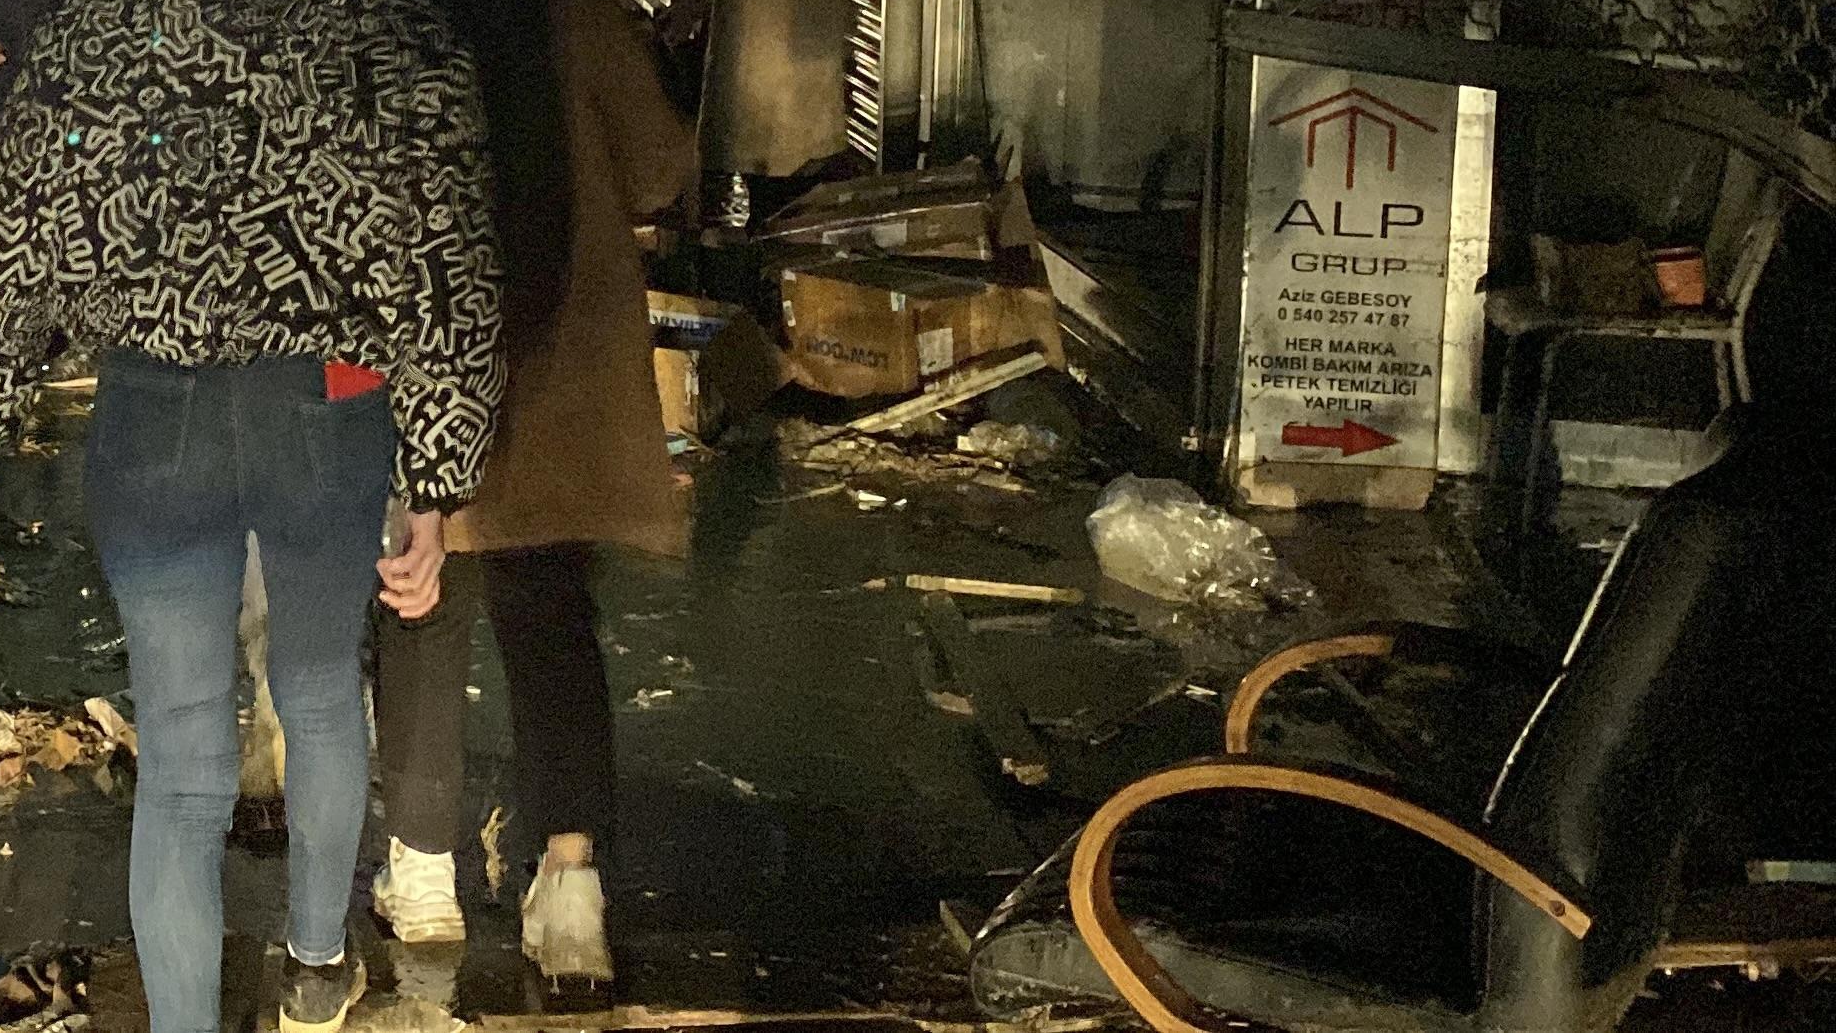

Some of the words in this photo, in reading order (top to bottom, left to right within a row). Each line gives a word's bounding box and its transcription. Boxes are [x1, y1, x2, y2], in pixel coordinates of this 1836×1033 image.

[1273, 198, 1425, 239] ALP
[1290, 252, 1407, 276] GRUP
[1278, 288, 1316, 304] Aziz
[1320, 290, 1413, 309] GEBESOY
[1277, 307, 1287, 321] 0
[1293, 308, 1323, 324] 540
[1328, 309, 1358, 325] 257
[1363, 312, 1385, 326] 47
[1285, 337, 1323, 351] HER
[1328, 339, 1397, 355] MARKA
[1247, 354, 1308, 371] KOMBİ
[1312, 357, 1372, 374] BAKIM
[1376, 362, 1433, 378] ARIZA
[1260, 374, 1321, 391] PETEK
[1302, 395, 1373, 413] YAPILIR
